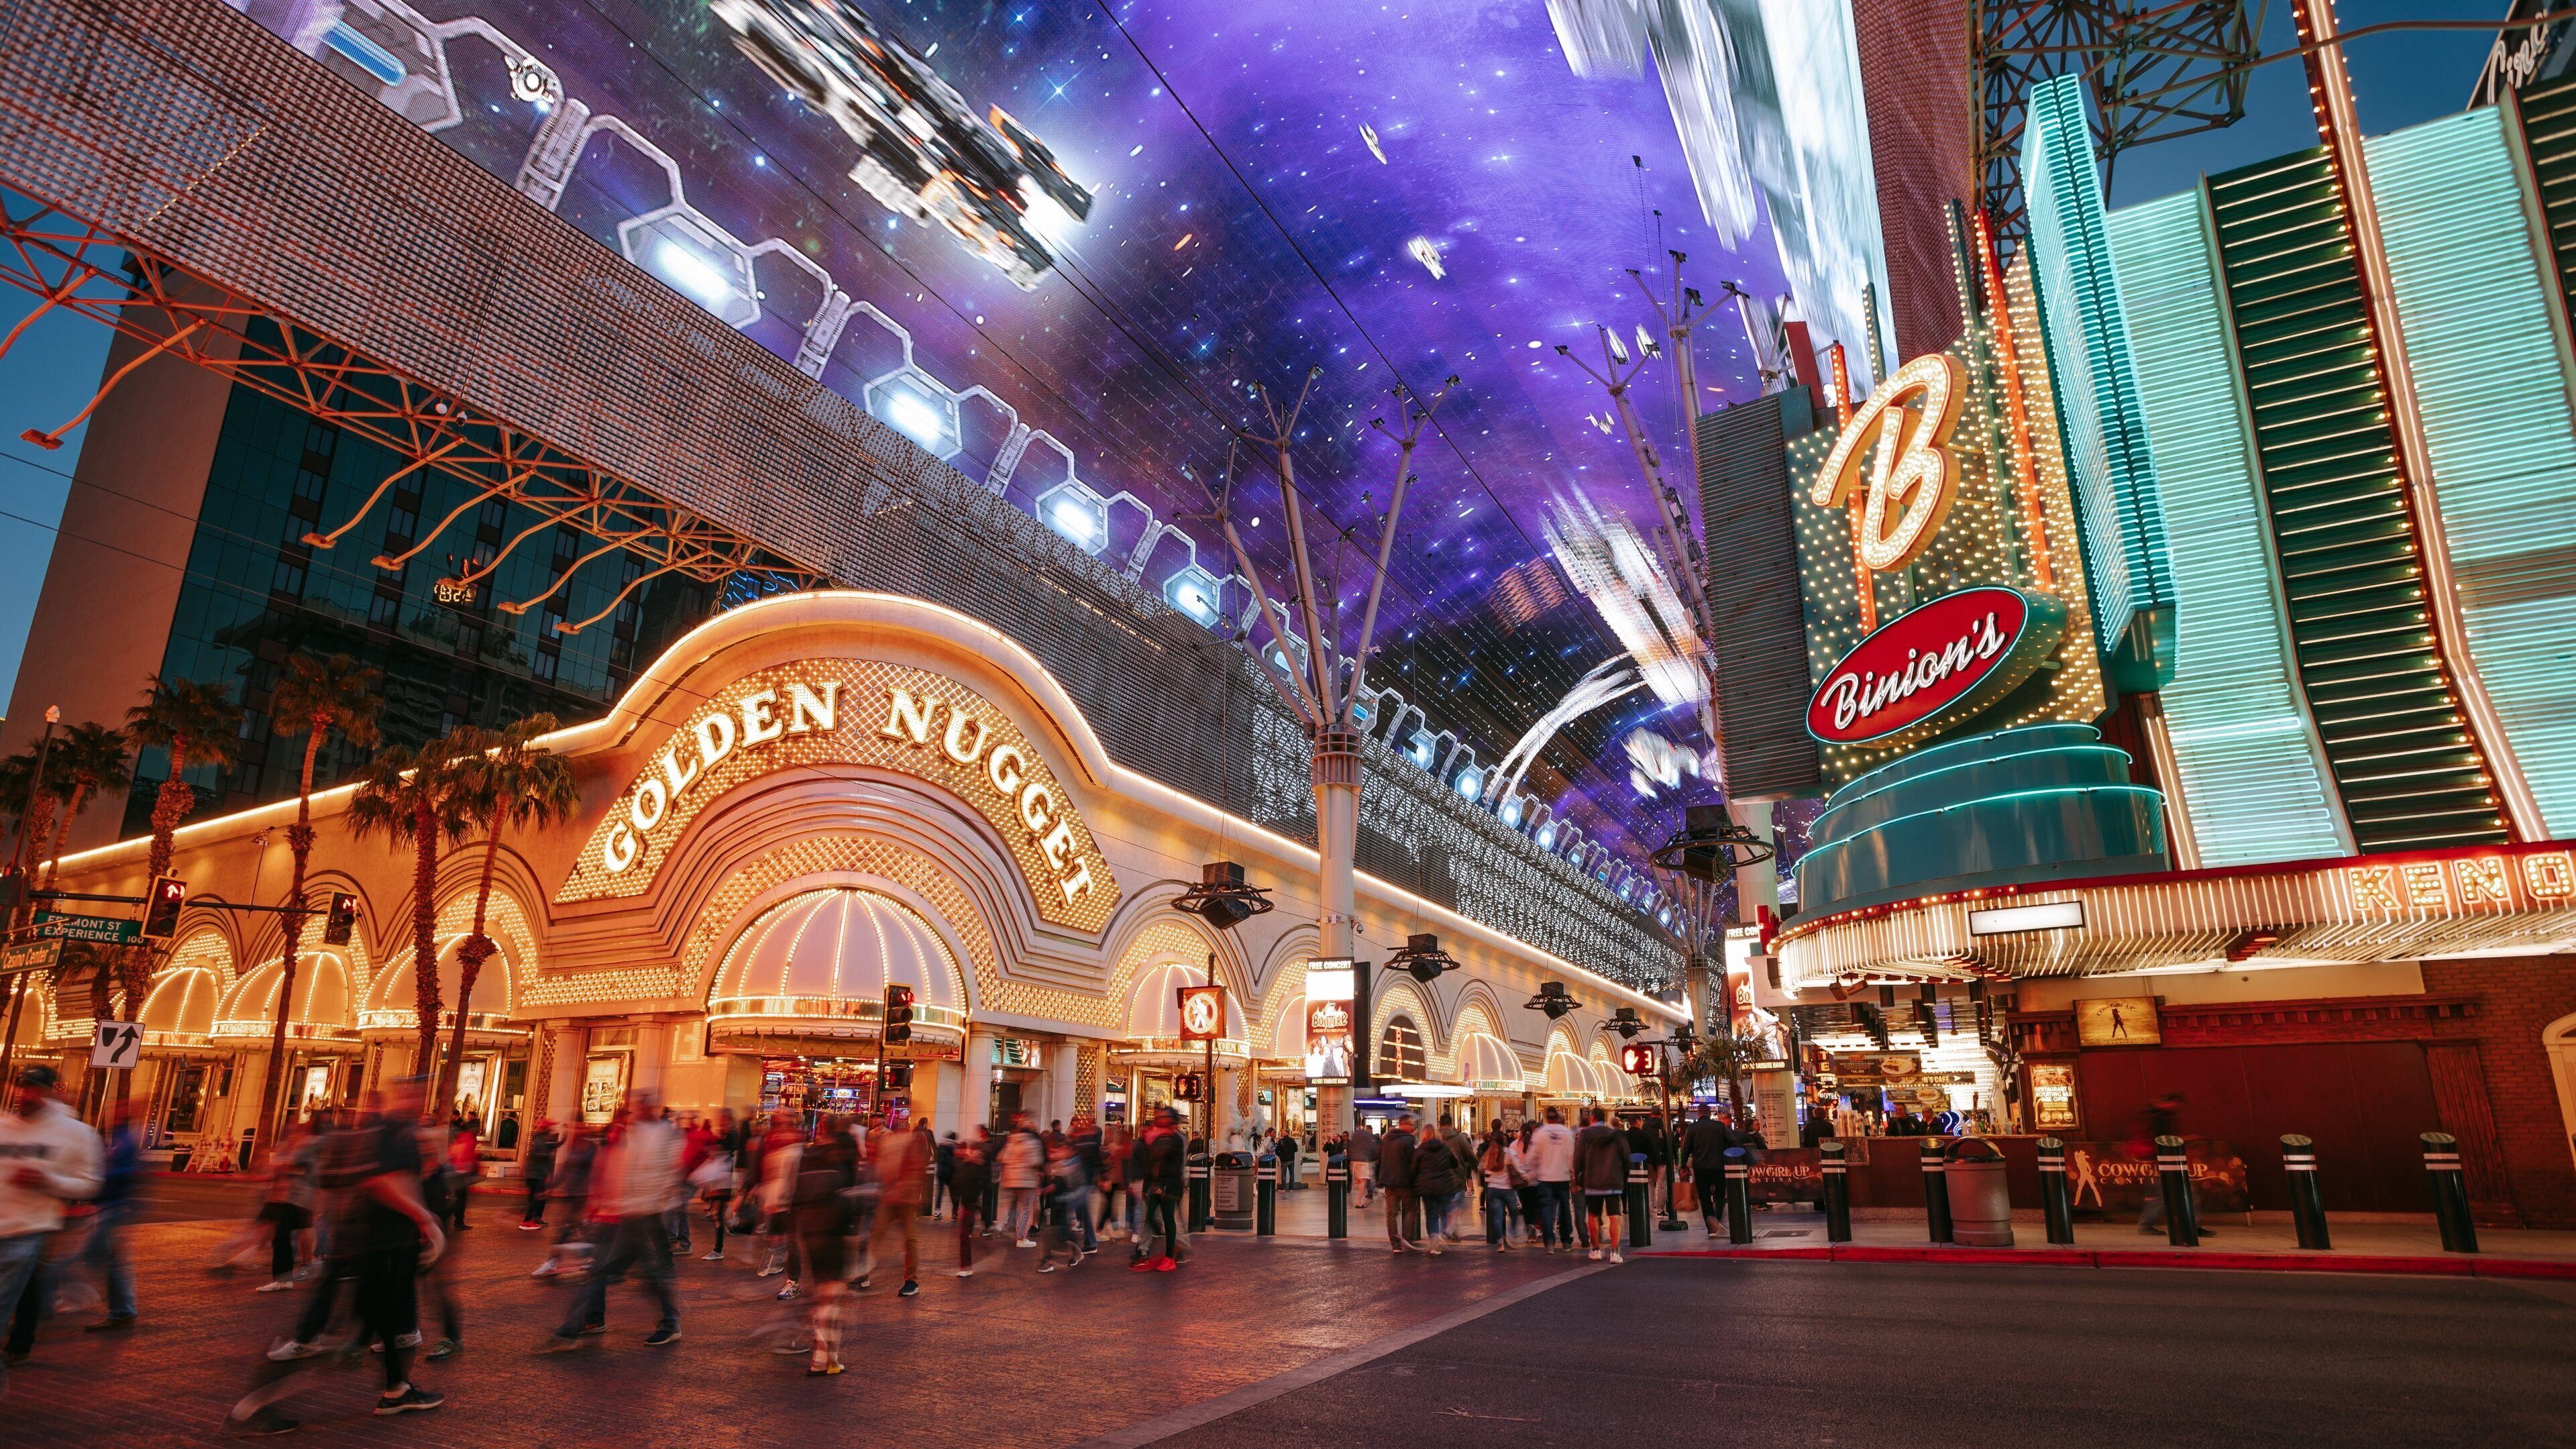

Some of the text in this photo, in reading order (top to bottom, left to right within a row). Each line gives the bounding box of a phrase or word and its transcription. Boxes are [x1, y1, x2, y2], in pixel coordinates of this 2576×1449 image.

[1811, 354, 1953, 570] B
[1820, 611, 2006, 731] Binion's
[604, 680, 1092, 907] GOLDEN NUGGET
[2347, 851, 2576, 911] KENO
[107, 922, 121, 931] ST
[1726, 925, 1760, 938] FREE CON
[44, 926, 119, 942] EXPERIENCE
[127, 935, 144, 944] 100
[3, 951, 25, 969] Casino
[25, 945, 49, 965] Center
[1308, 960, 1352, 970] FREE CONCERT
[1644, 1050, 1652, 1069] 3
[1935, 1075, 1949, 1083] CAFÉ
[1747, 1166, 1810, 1177] OWGIRL UP
[2098, 1164, 2159, 1177] COWGI
